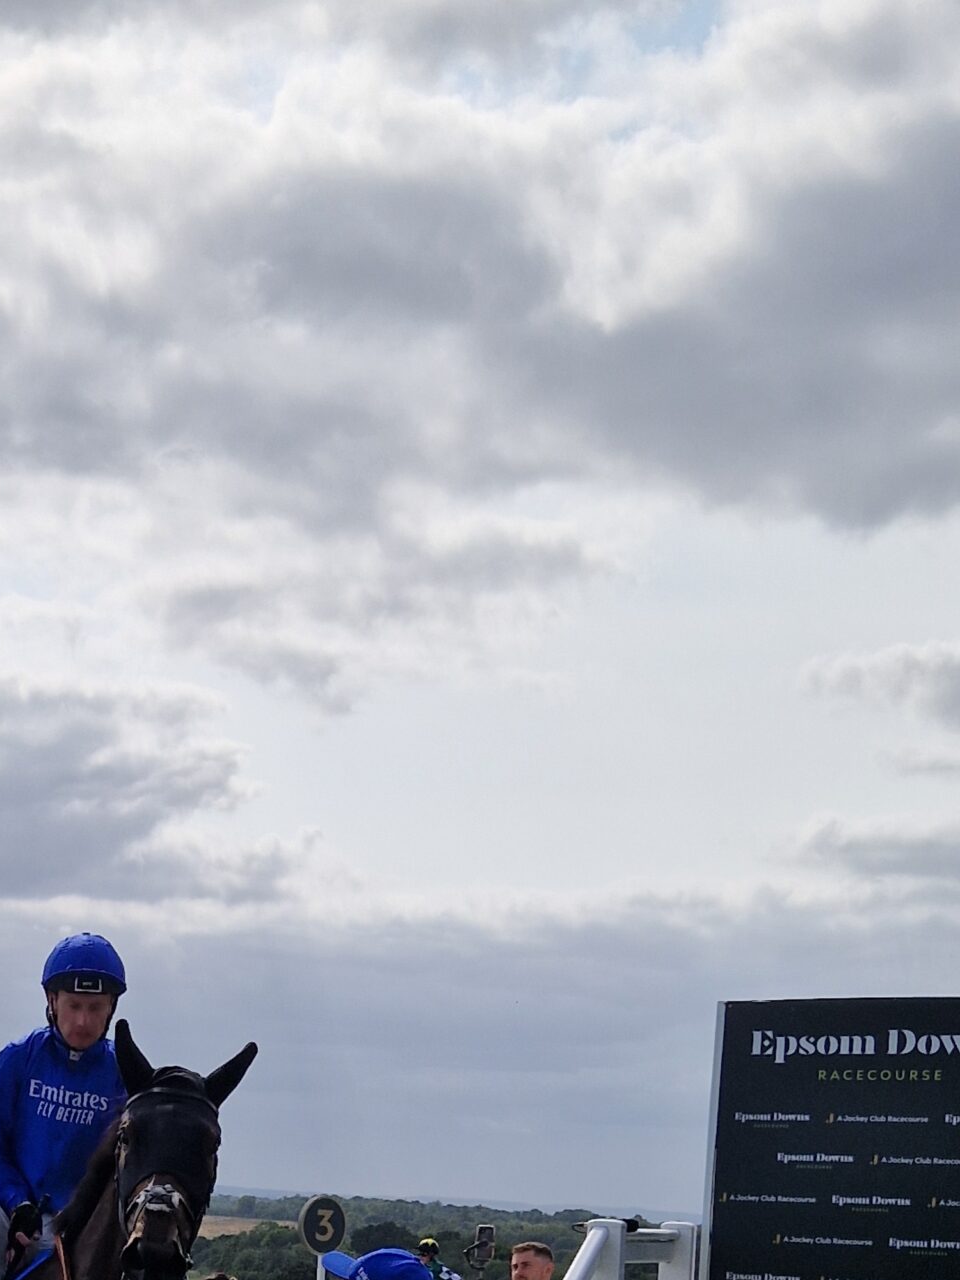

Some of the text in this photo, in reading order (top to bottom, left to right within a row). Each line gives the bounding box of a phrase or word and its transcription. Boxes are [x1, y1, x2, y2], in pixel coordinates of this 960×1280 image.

[751, 1030, 876, 1064] Epsom
[818, 1069, 943, 1081] RACECOURSE
[29, 1079, 109, 1111] Emirates
[37, 1101, 95, 1126] FLY BETTER
[734, 1112, 810, 1123] Epsom Downs
[777, 1152, 854, 1164] Epsom Downs
[831, 1194, 912, 1207] Epsom Downs
[315, 1209, 335, 1242] 3
[888, 1237, 929, 1250] Epsom
